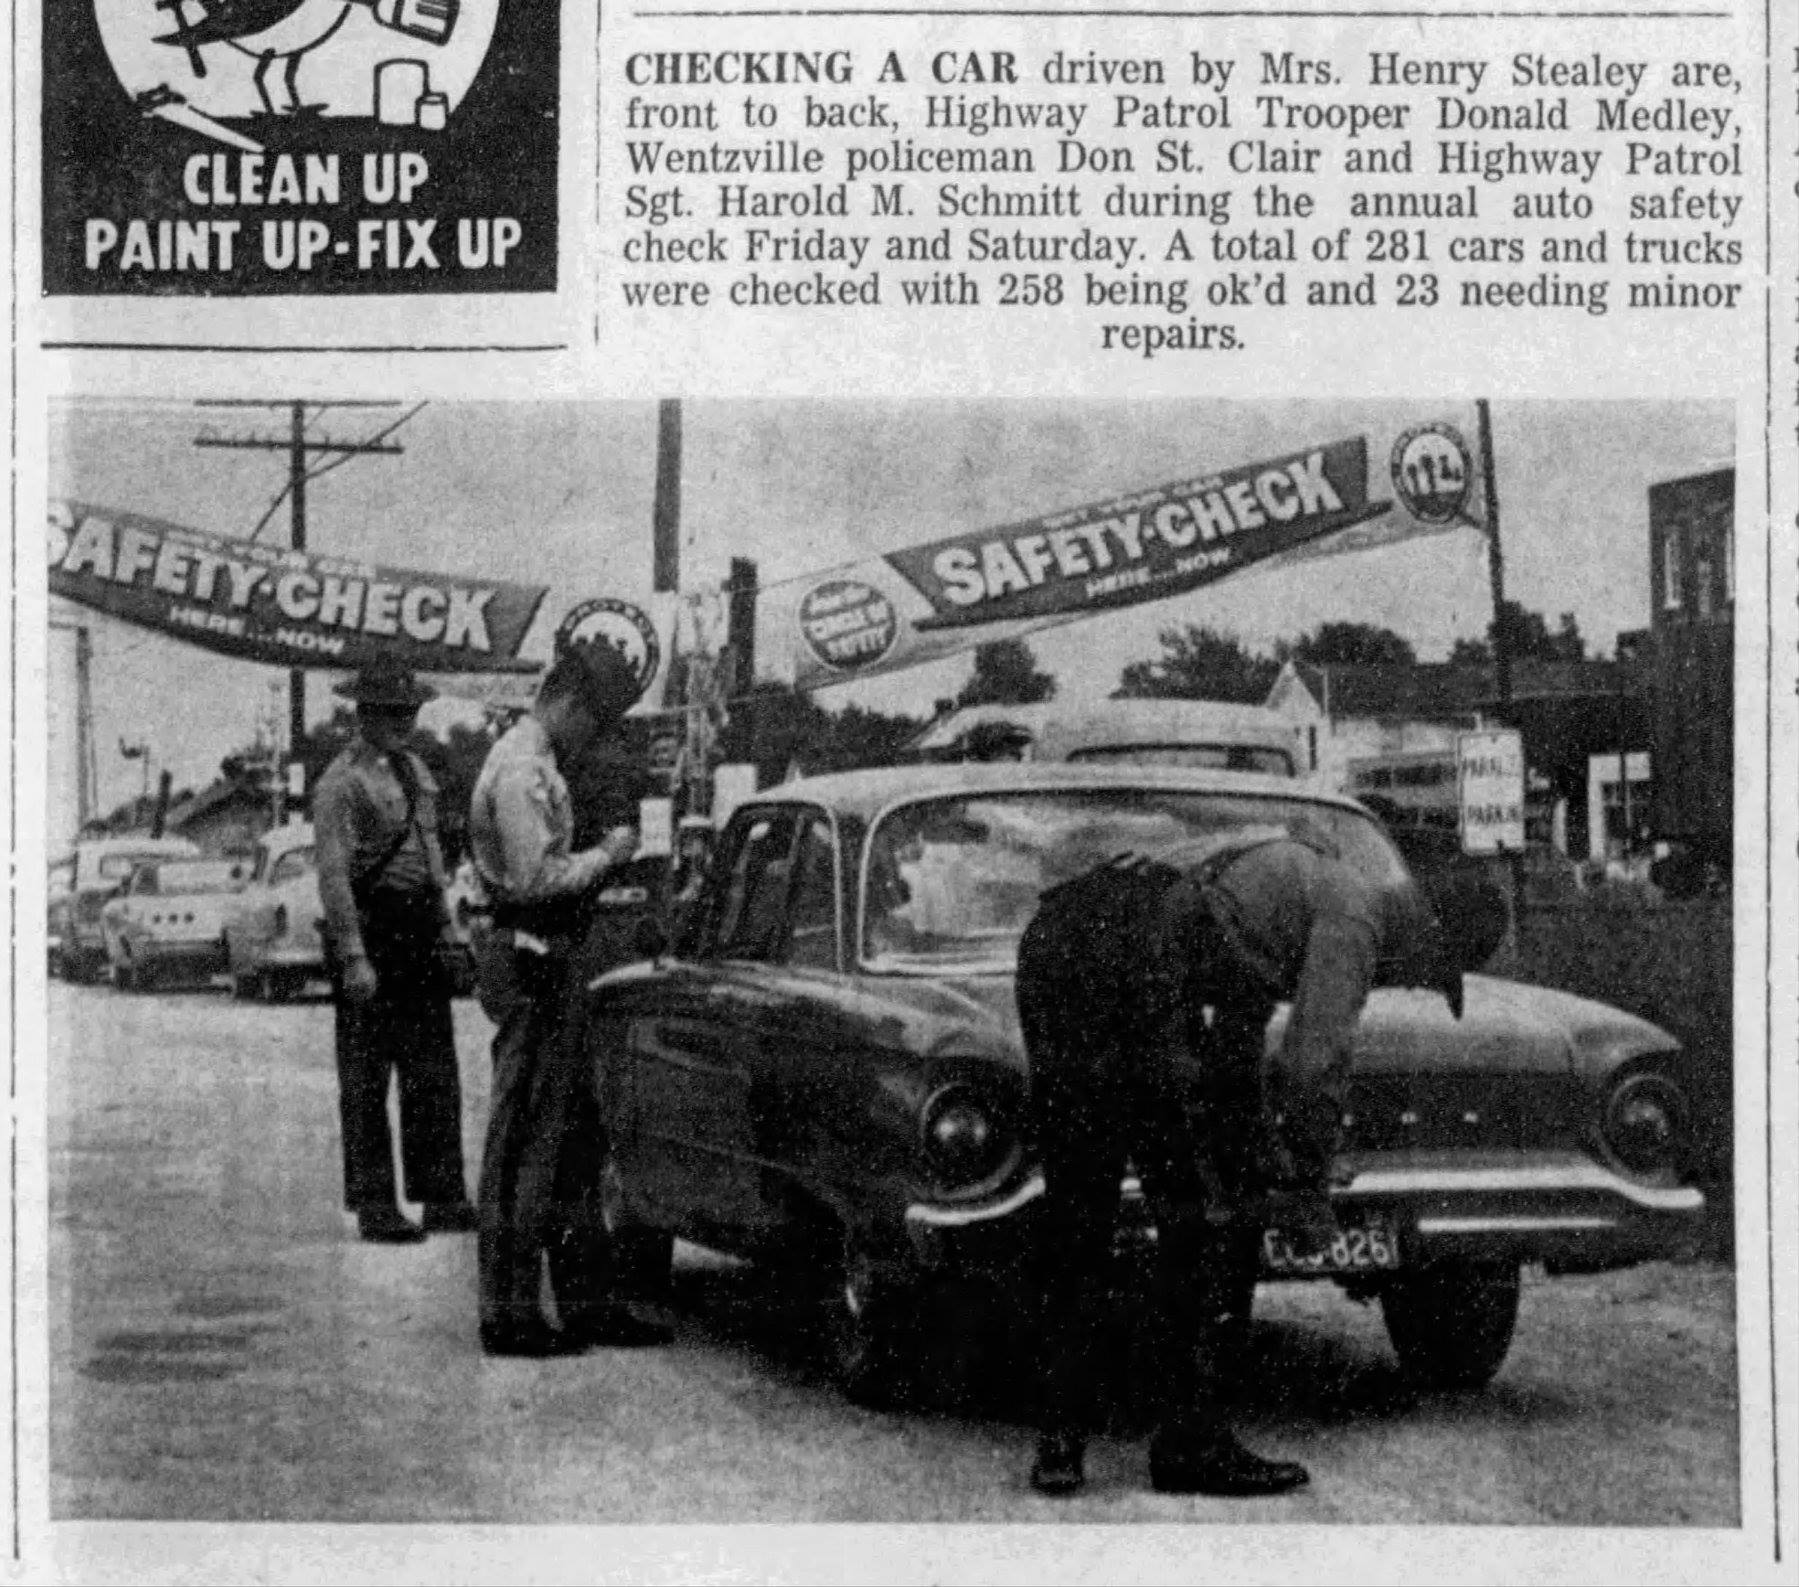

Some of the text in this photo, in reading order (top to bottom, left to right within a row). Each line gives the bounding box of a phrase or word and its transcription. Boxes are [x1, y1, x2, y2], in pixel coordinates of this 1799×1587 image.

[625, 50, 1741, 97] CHECKING A CAR driven by Mrs. Henry Stealey are,
[627, 94, 1741, 138] front to back, Highway Patrol Trooper Donald Medley,
[184, 153, 428, 204] CLEAN UP
[626, 139, 1742, 184] Wentzville policeman Don St. Clair and Highway Patrol
[625, 183, 1742, 228] Sgt. Harold M. Schmitt during the annual auto safety
[86, 220, 240, 270] PAINT
[459, 218, 521, 268] UP
[623, 227, 1742, 270] check Friday and Saturday. A total of 281 cars and trucks
[622, 271, 1742, 316] were checked with 258 being ok'd and 23 needing minor
[1102, 316, 1245, 359] repairs.
